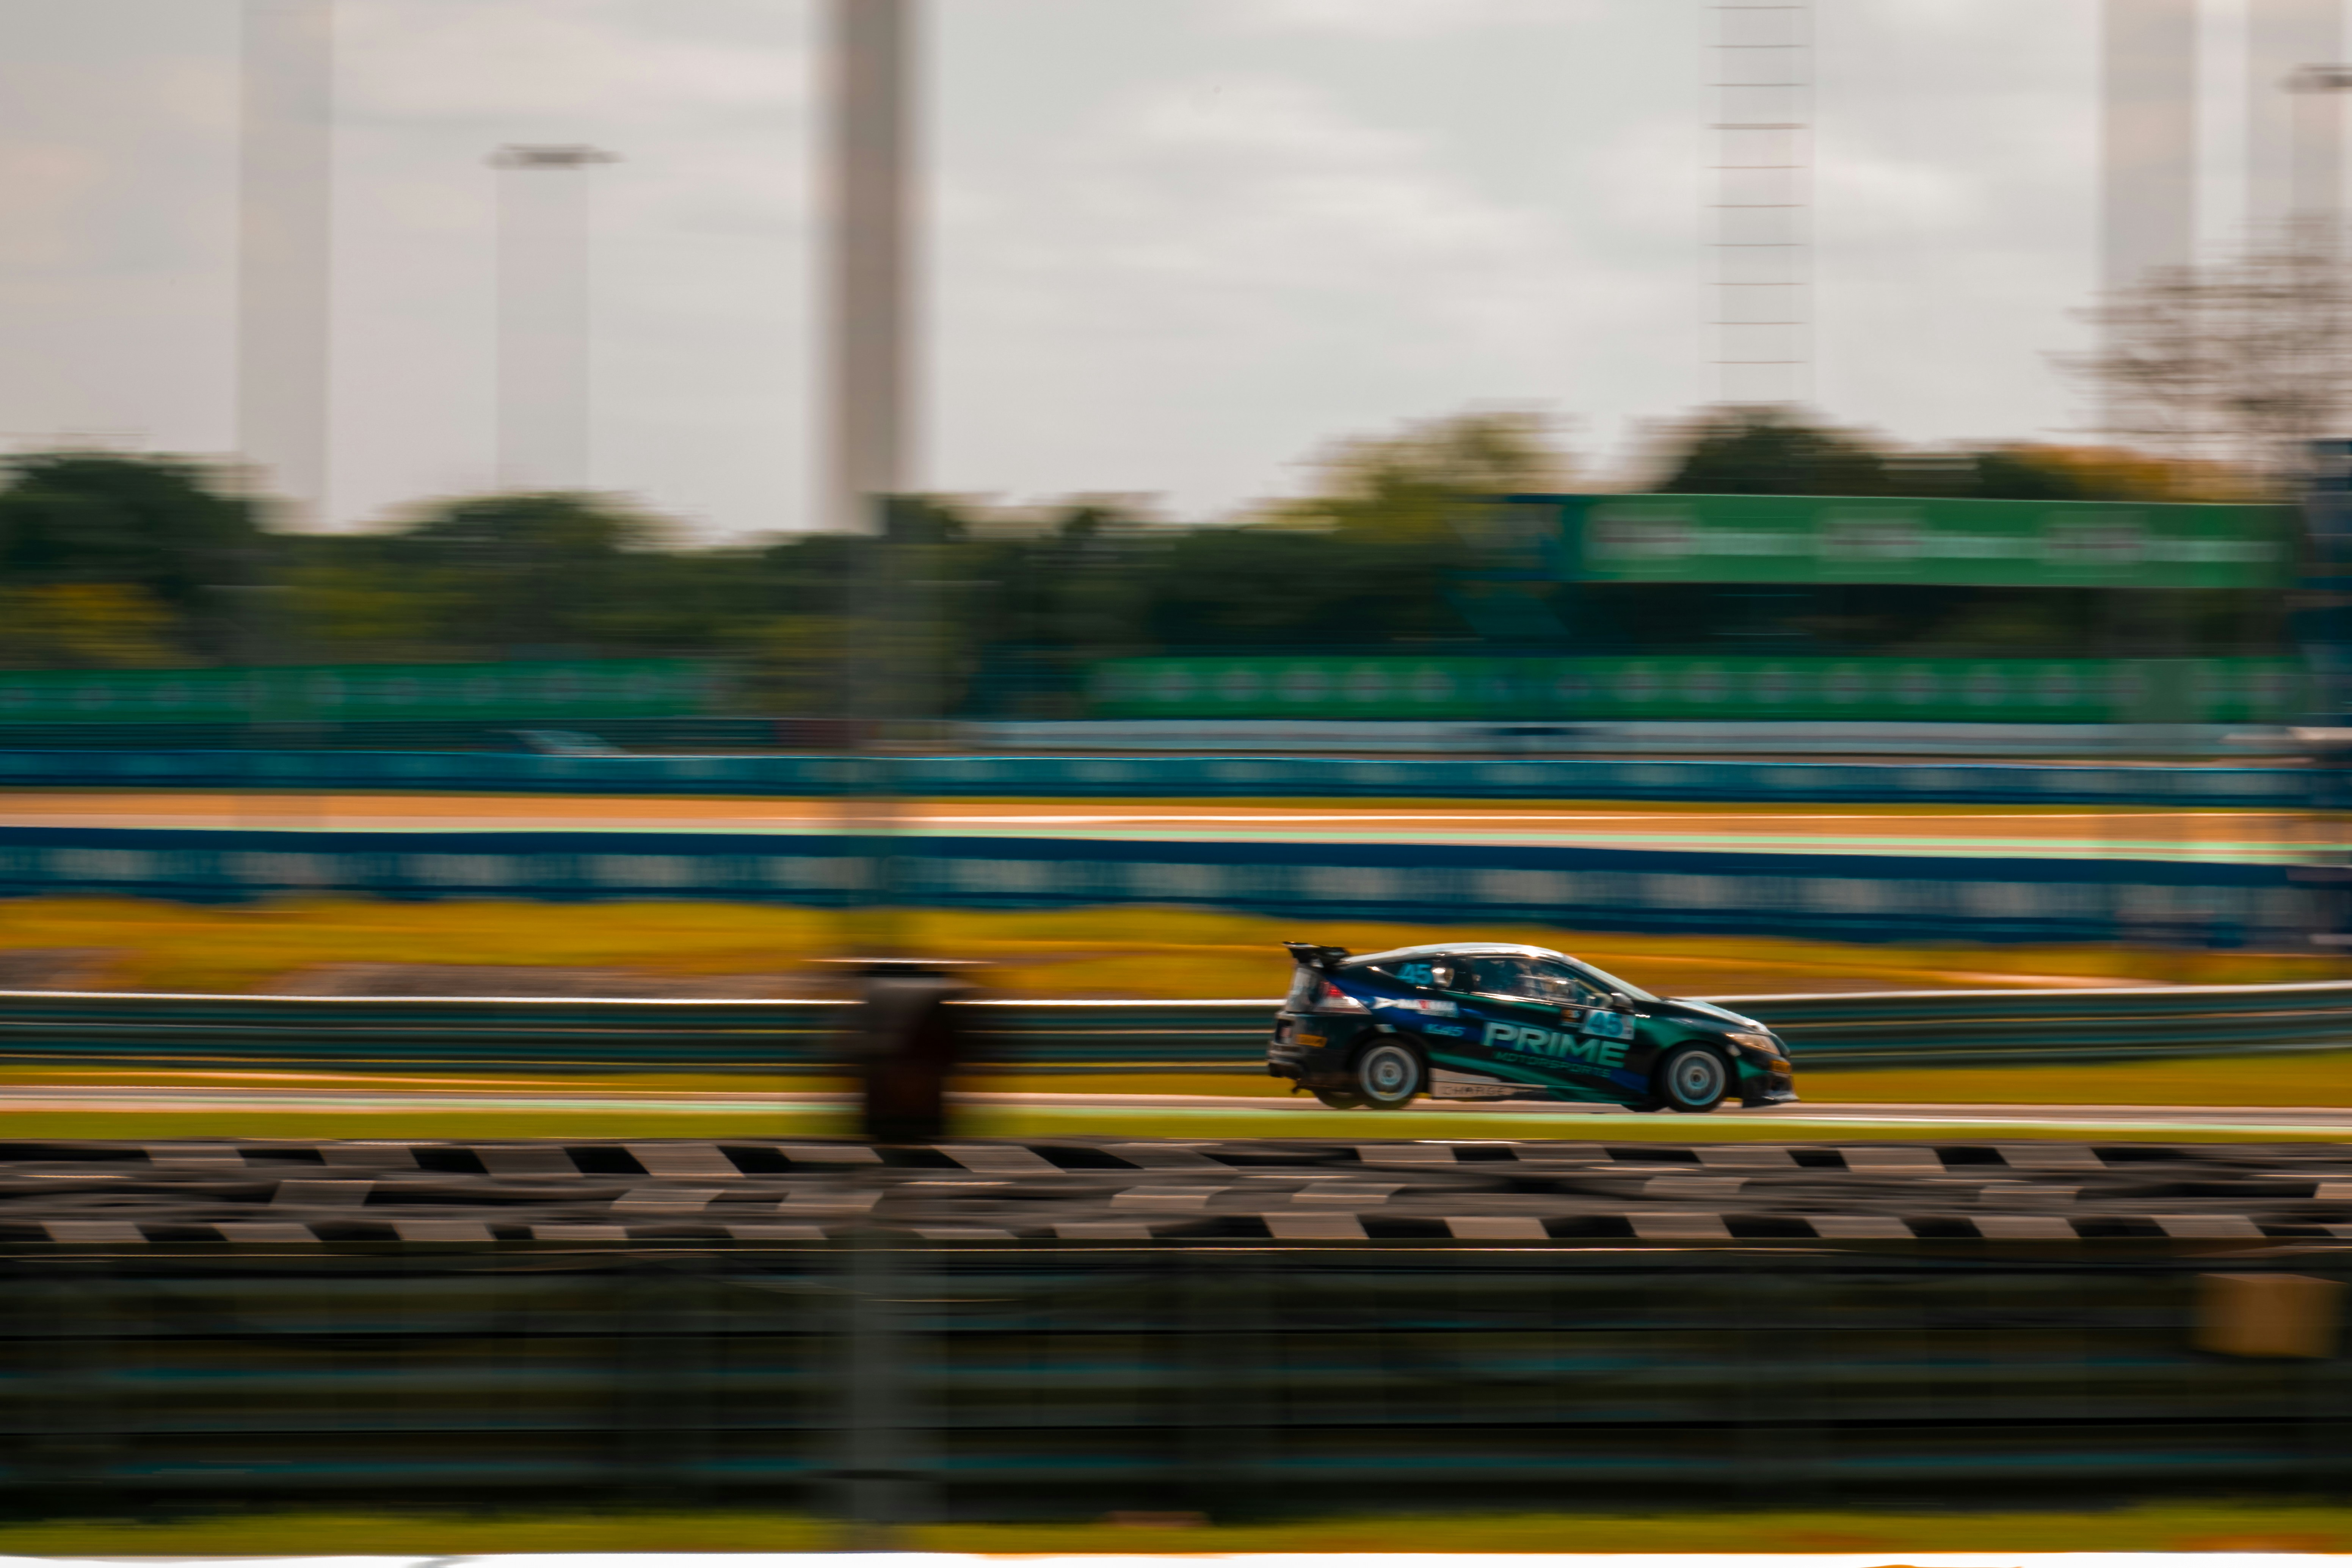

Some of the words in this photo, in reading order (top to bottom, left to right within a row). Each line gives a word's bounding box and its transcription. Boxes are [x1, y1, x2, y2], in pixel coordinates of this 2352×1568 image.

[1397, 963, 1433, 984] 45
[1587, 1011, 1623, 1036] 45
[1482, 1021, 1630, 1068] PRIME
[1493, 1051, 1612, 1078] MOTORSPORTS
